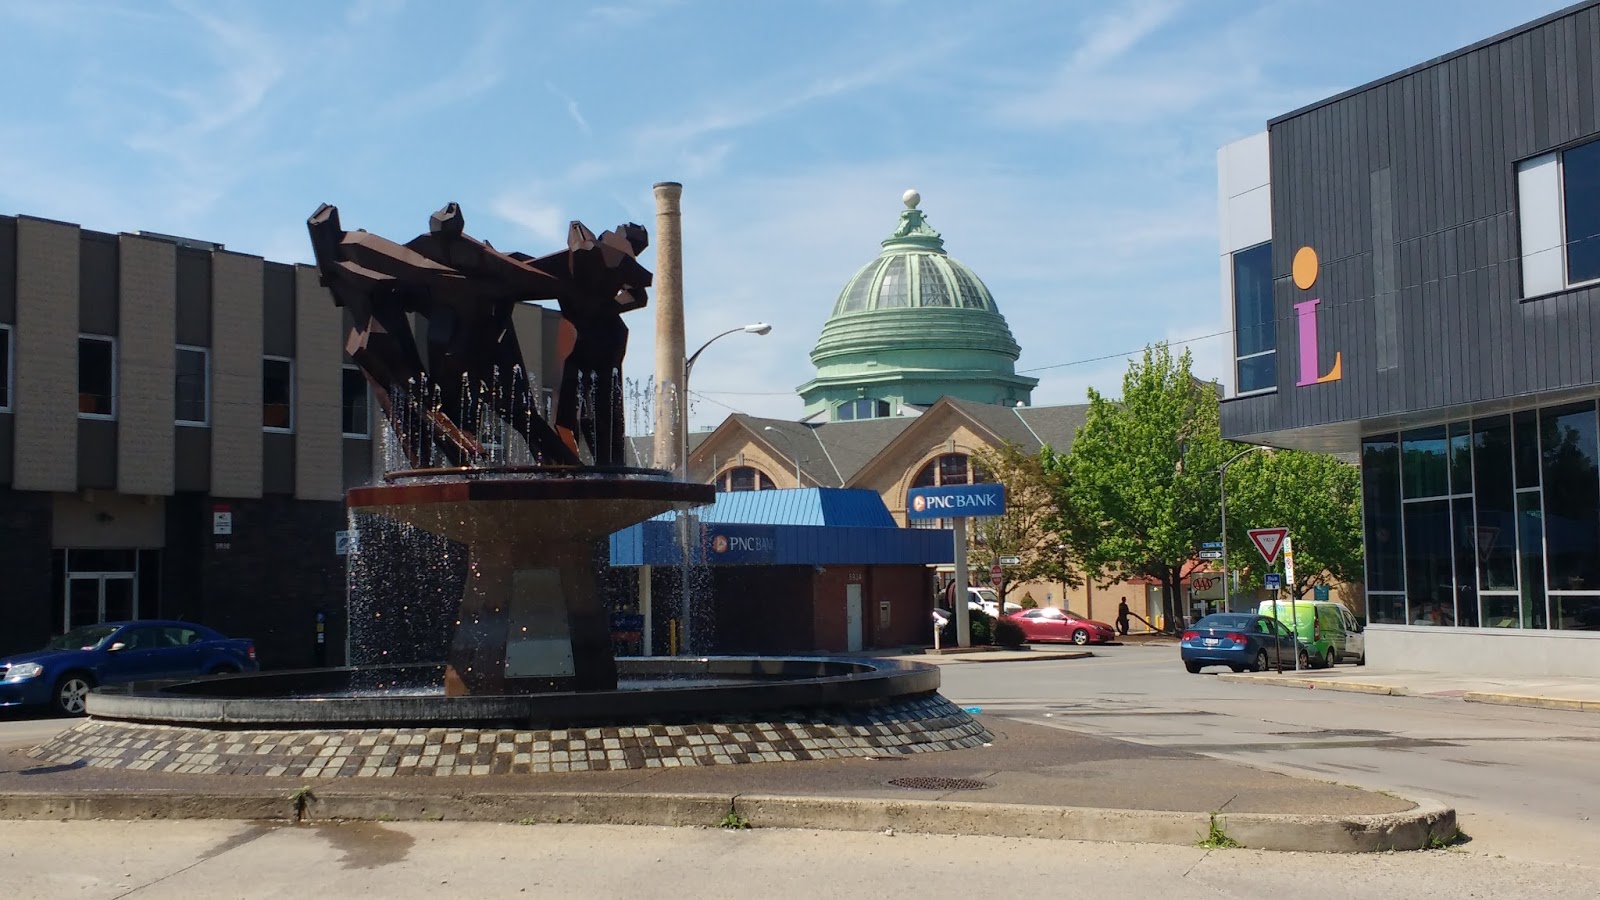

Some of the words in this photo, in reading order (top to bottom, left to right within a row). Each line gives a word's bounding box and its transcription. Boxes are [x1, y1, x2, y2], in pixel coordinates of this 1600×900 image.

[926, 495, 955, 509] PNC
[955, 493, 997, 508] BANK
[729, 536, 755, 551] PNC
